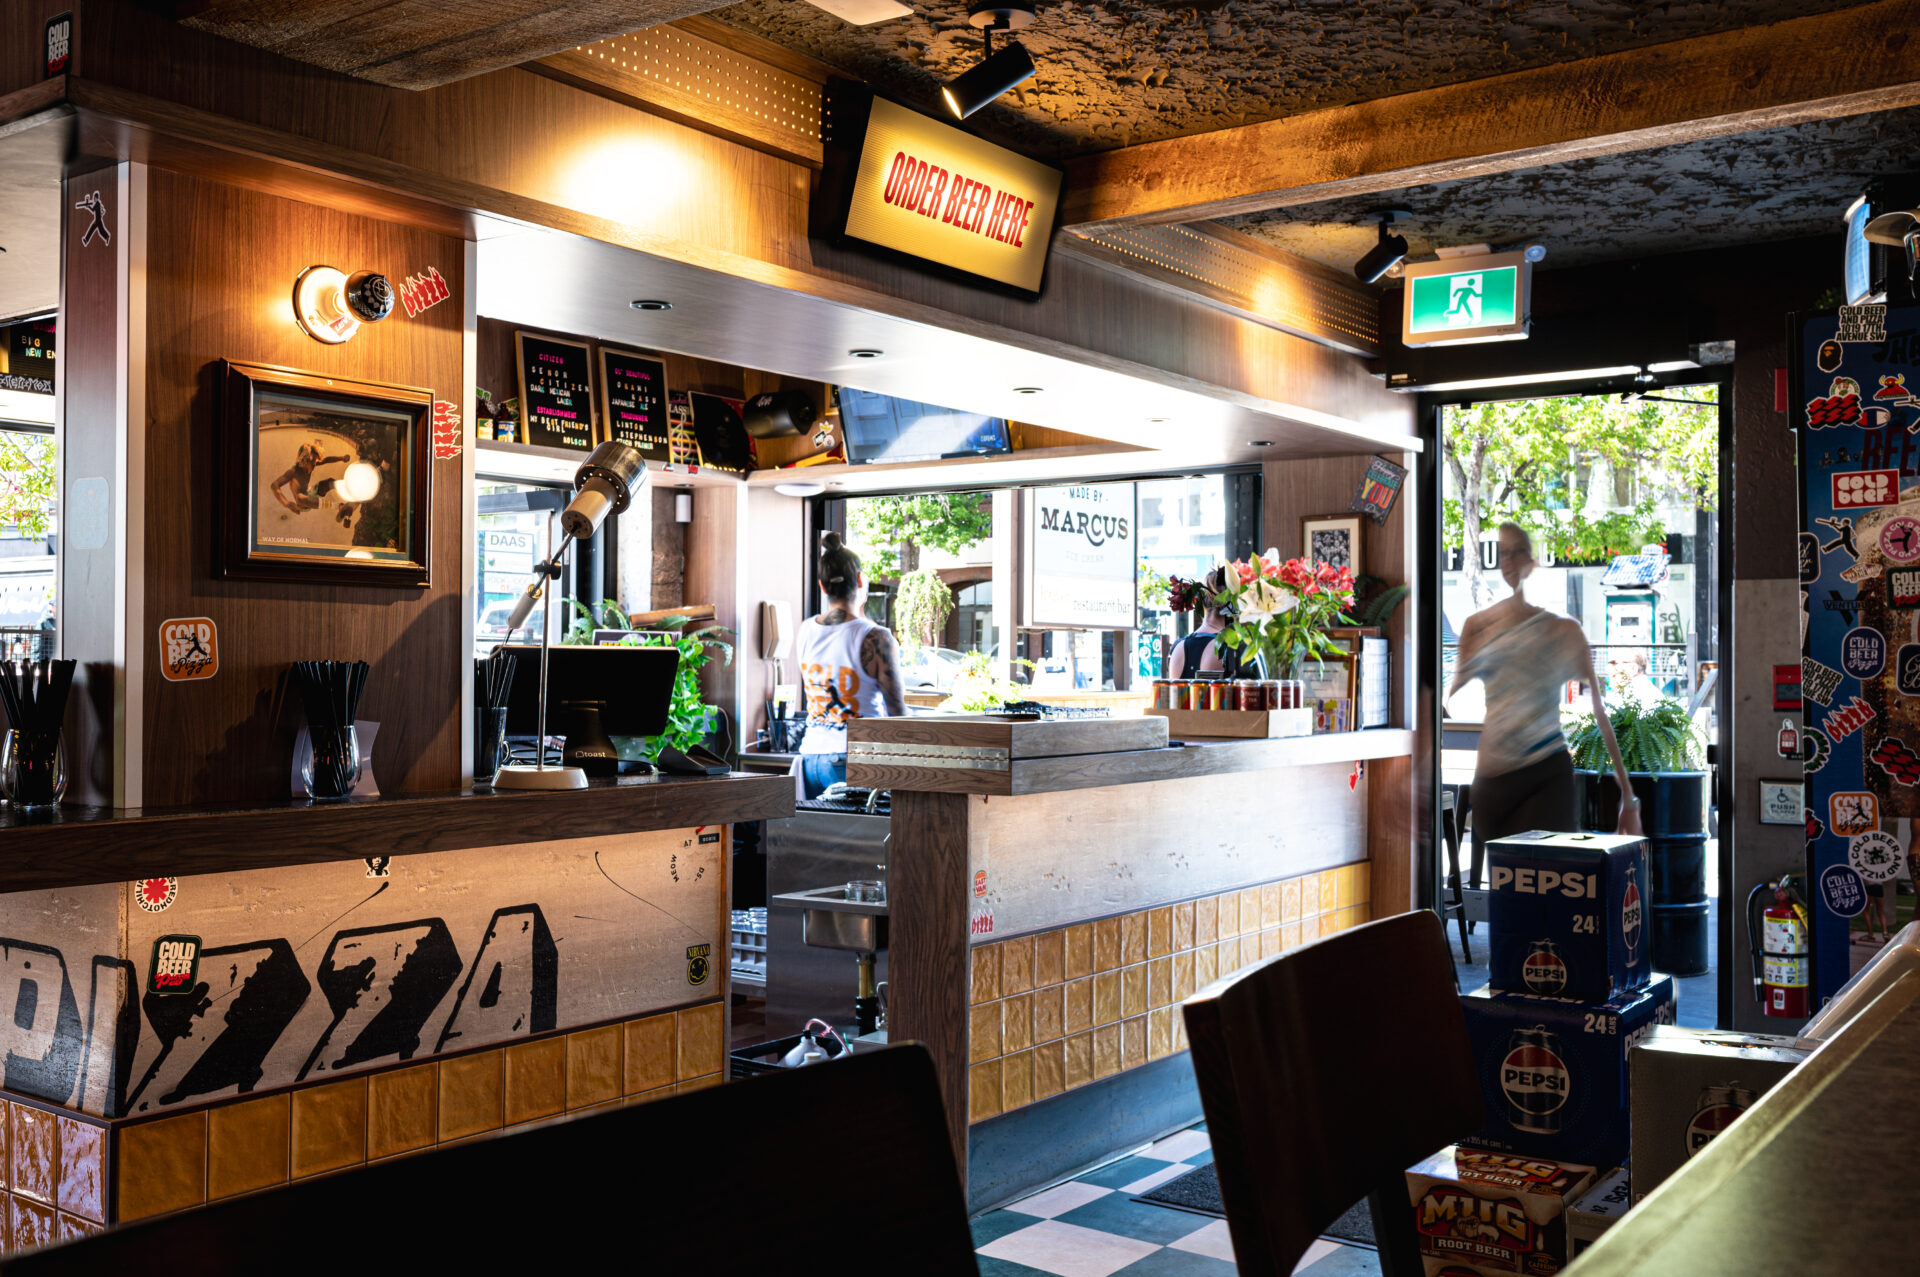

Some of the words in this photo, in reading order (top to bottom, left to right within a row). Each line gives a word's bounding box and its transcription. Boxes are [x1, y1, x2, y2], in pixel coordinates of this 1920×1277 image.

[48, 20, 70, 46] COLD
[48, 40, 69, 64] BEER
[884, 151, 949, 219] ORDER
[942, 174, 992, 234] BEER
[986, 189, 1034, 248] HERE
[1840, 306, 1863, 316] COLD
[1864, 305, 1886, 315] BEER
[1840, 315, 1859, 324] AND
[1860, 314, 1884, 324] PIZZA
[1836, 332, 1868, 341] AVENUE
[1869, 331, 1885, 341] SW
[26, 346, 42, 358] NEW
[1837, 474, 1889, 491] COLD
[1069, 487, 1090, 500] MADE
[1093, 489, 1103, 503] BY
[1361, 477, 1395, 509] YOU
[1041, 507, 1129, 546] MARCUS
[490, 534, 526, 548] DAAS
[165, 624, 211, 646] COLD
[1850, 636, 1879, 649] COLD
[1850, 649, 1878, 660] BEER
[1822, 667, 1842, 683] BEER
[1770, 803, 1796, 811] PUSH
[1833, 796, 1873, 810] COLD
[1851, 835, 1870, 859] COLD
[1872, 833, 1900, 852] BEER
[1855, 861, 1886, 879] PIZZA
[1887, 855, 1902, 875] AND
[1491, 865, 1597, 899] PEPSI
[1826, 873, 1856, 889] COLD
[1829, 885, 1859, 899] BEER
[1572, 914, 1595, 935] 24
[1623, 907, 1641, 926] PEPSI
[159, 941, 196, 961] COLD
[686, 944, 710, 958] NIRVANA
[156, 958, 192, 977] BEER
[1525, 967, 1564, 979] PEPSI
[1583, 1013, 1607, 1035] 24
[1608, 1016, 1617, 1035] CANS
[1504, 1069, 1566, 1091] PEPSI
[1455, 1150, 1557, 1178] MUG
[1484, 1174, 1523, 1187] BEER
[1422, 1193, 1527, 1241] MUG
[1437, 1238, 1473, 1250] ROOT
[1475, 1243, 1511, 1260] BEER
